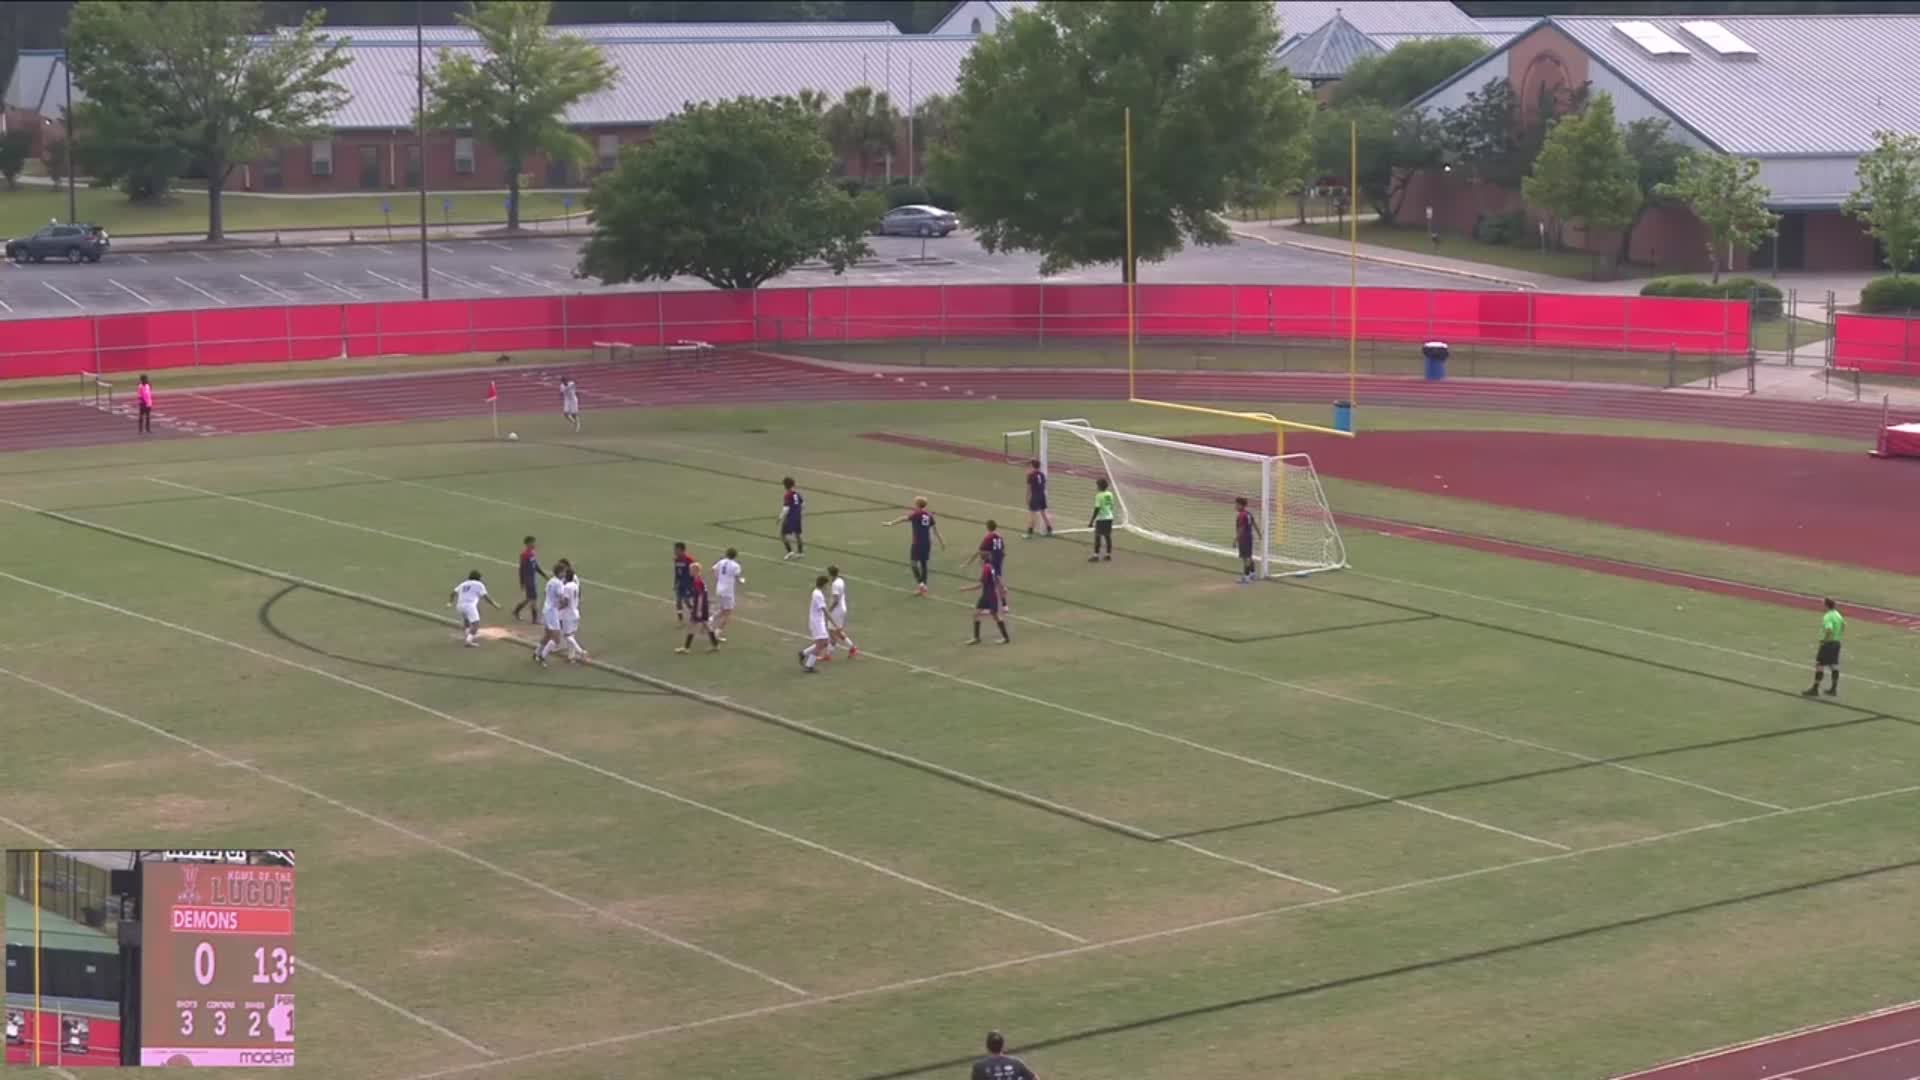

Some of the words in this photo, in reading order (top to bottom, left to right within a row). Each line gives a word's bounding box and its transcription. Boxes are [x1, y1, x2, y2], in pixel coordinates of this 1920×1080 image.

[173, 910, 238, 929] DEMONS
[194, 942, 216, 985] 0
[181, 1010, 193, 1035] 3
[214, 1010, 226, 1035] 3
[248, 1011, 261, 1036] 2
